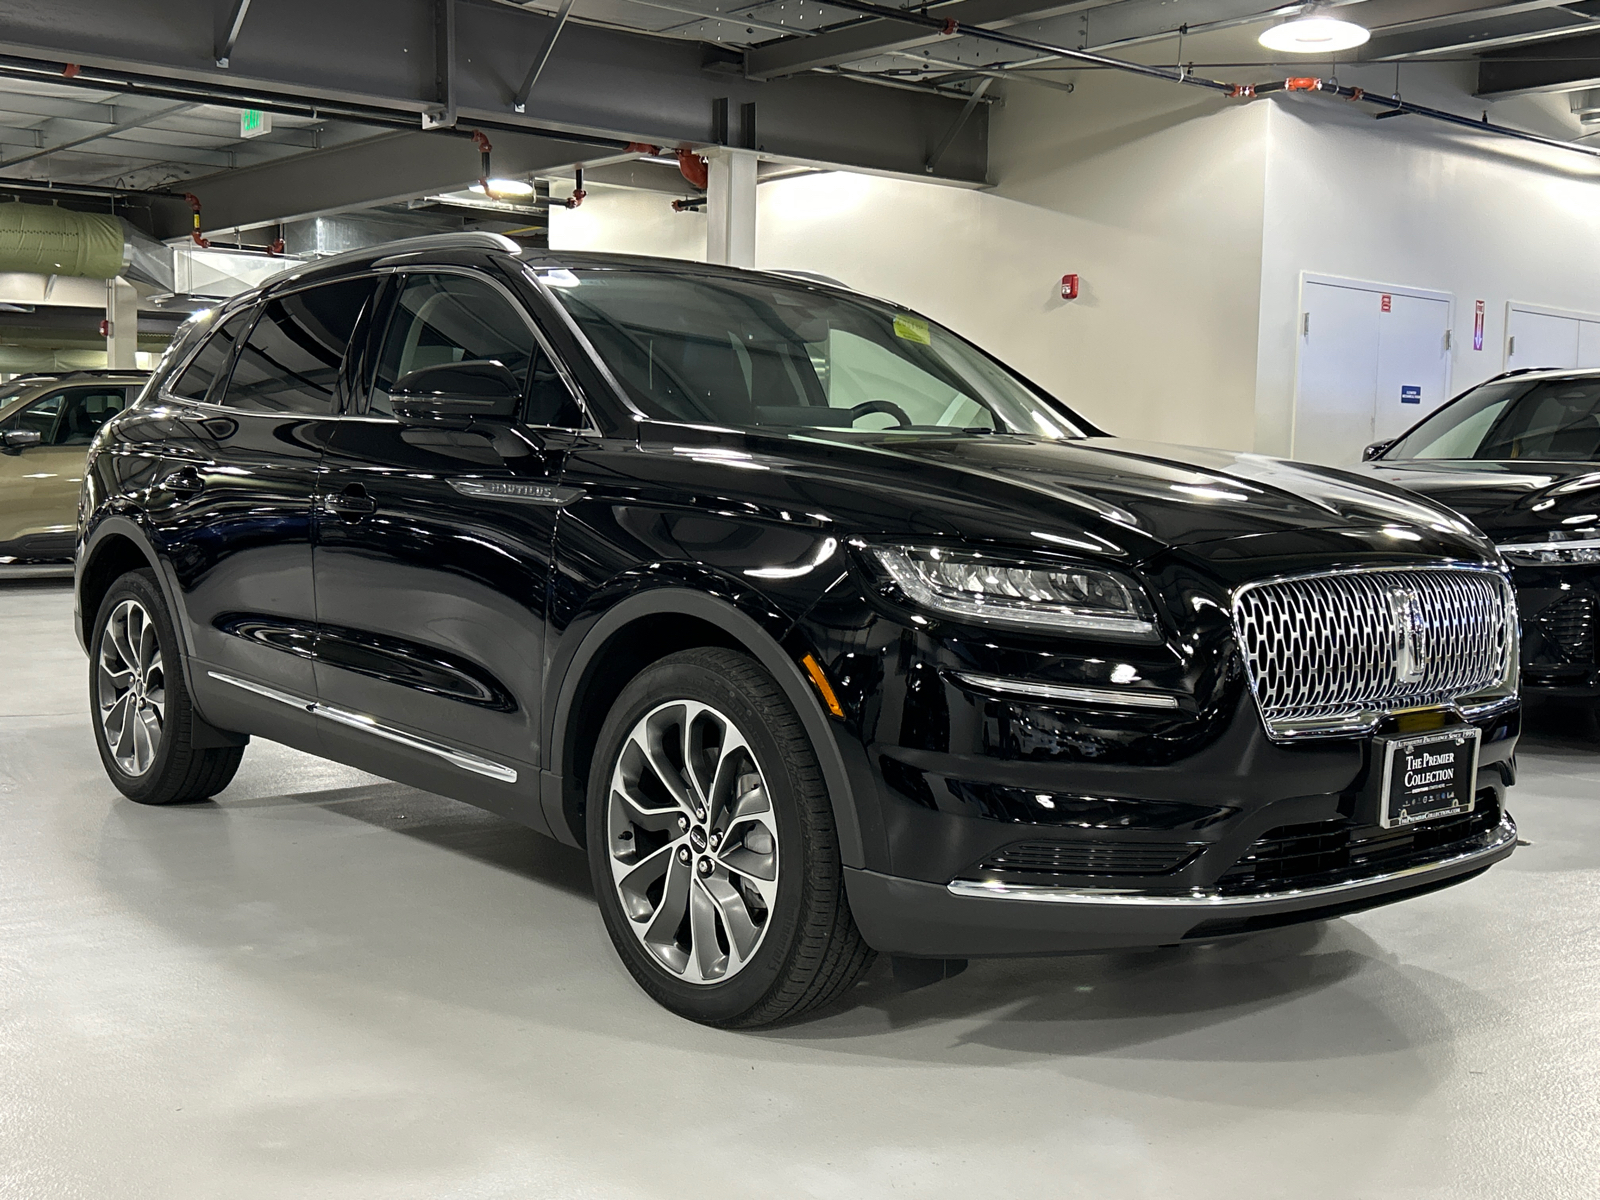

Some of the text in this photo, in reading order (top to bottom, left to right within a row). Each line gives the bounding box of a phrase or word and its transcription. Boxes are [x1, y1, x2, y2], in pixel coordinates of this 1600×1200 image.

[491, 482, 552, 498] NAUTILUS
[1405, 752, 1455, 771] THE PREMIER
[1404, 768, 1454, 788] COLLECTION
